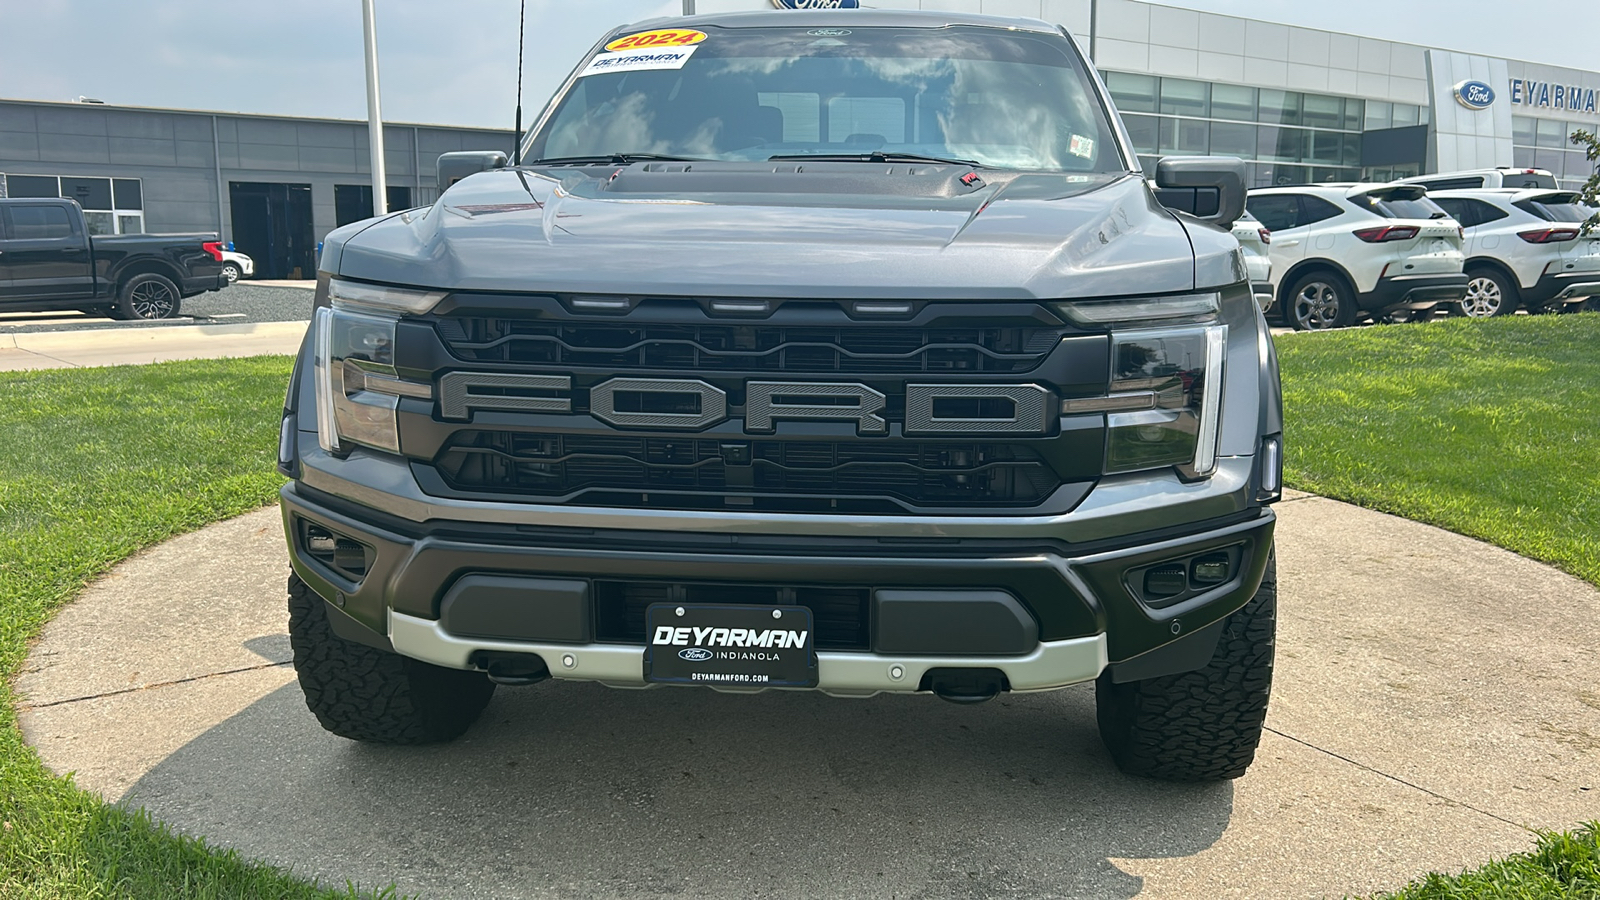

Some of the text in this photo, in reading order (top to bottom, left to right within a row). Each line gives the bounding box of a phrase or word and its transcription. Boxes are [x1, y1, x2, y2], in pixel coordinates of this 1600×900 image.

[612, 32, 700, 49] 2024
[592, 53, 685, 67] DEYARMAN
[1467, 85, 1490, 103] Ford
[1511, 79, 1600, 112] EYARMA
[440, 371, 1049, 434] FORD
[652, 626, 808, 649] DEYARMAN
[684, 650, 780, 661] Ford INDIANOLA
[691, 672, 769, 682] DEYARMANFORD.COM
